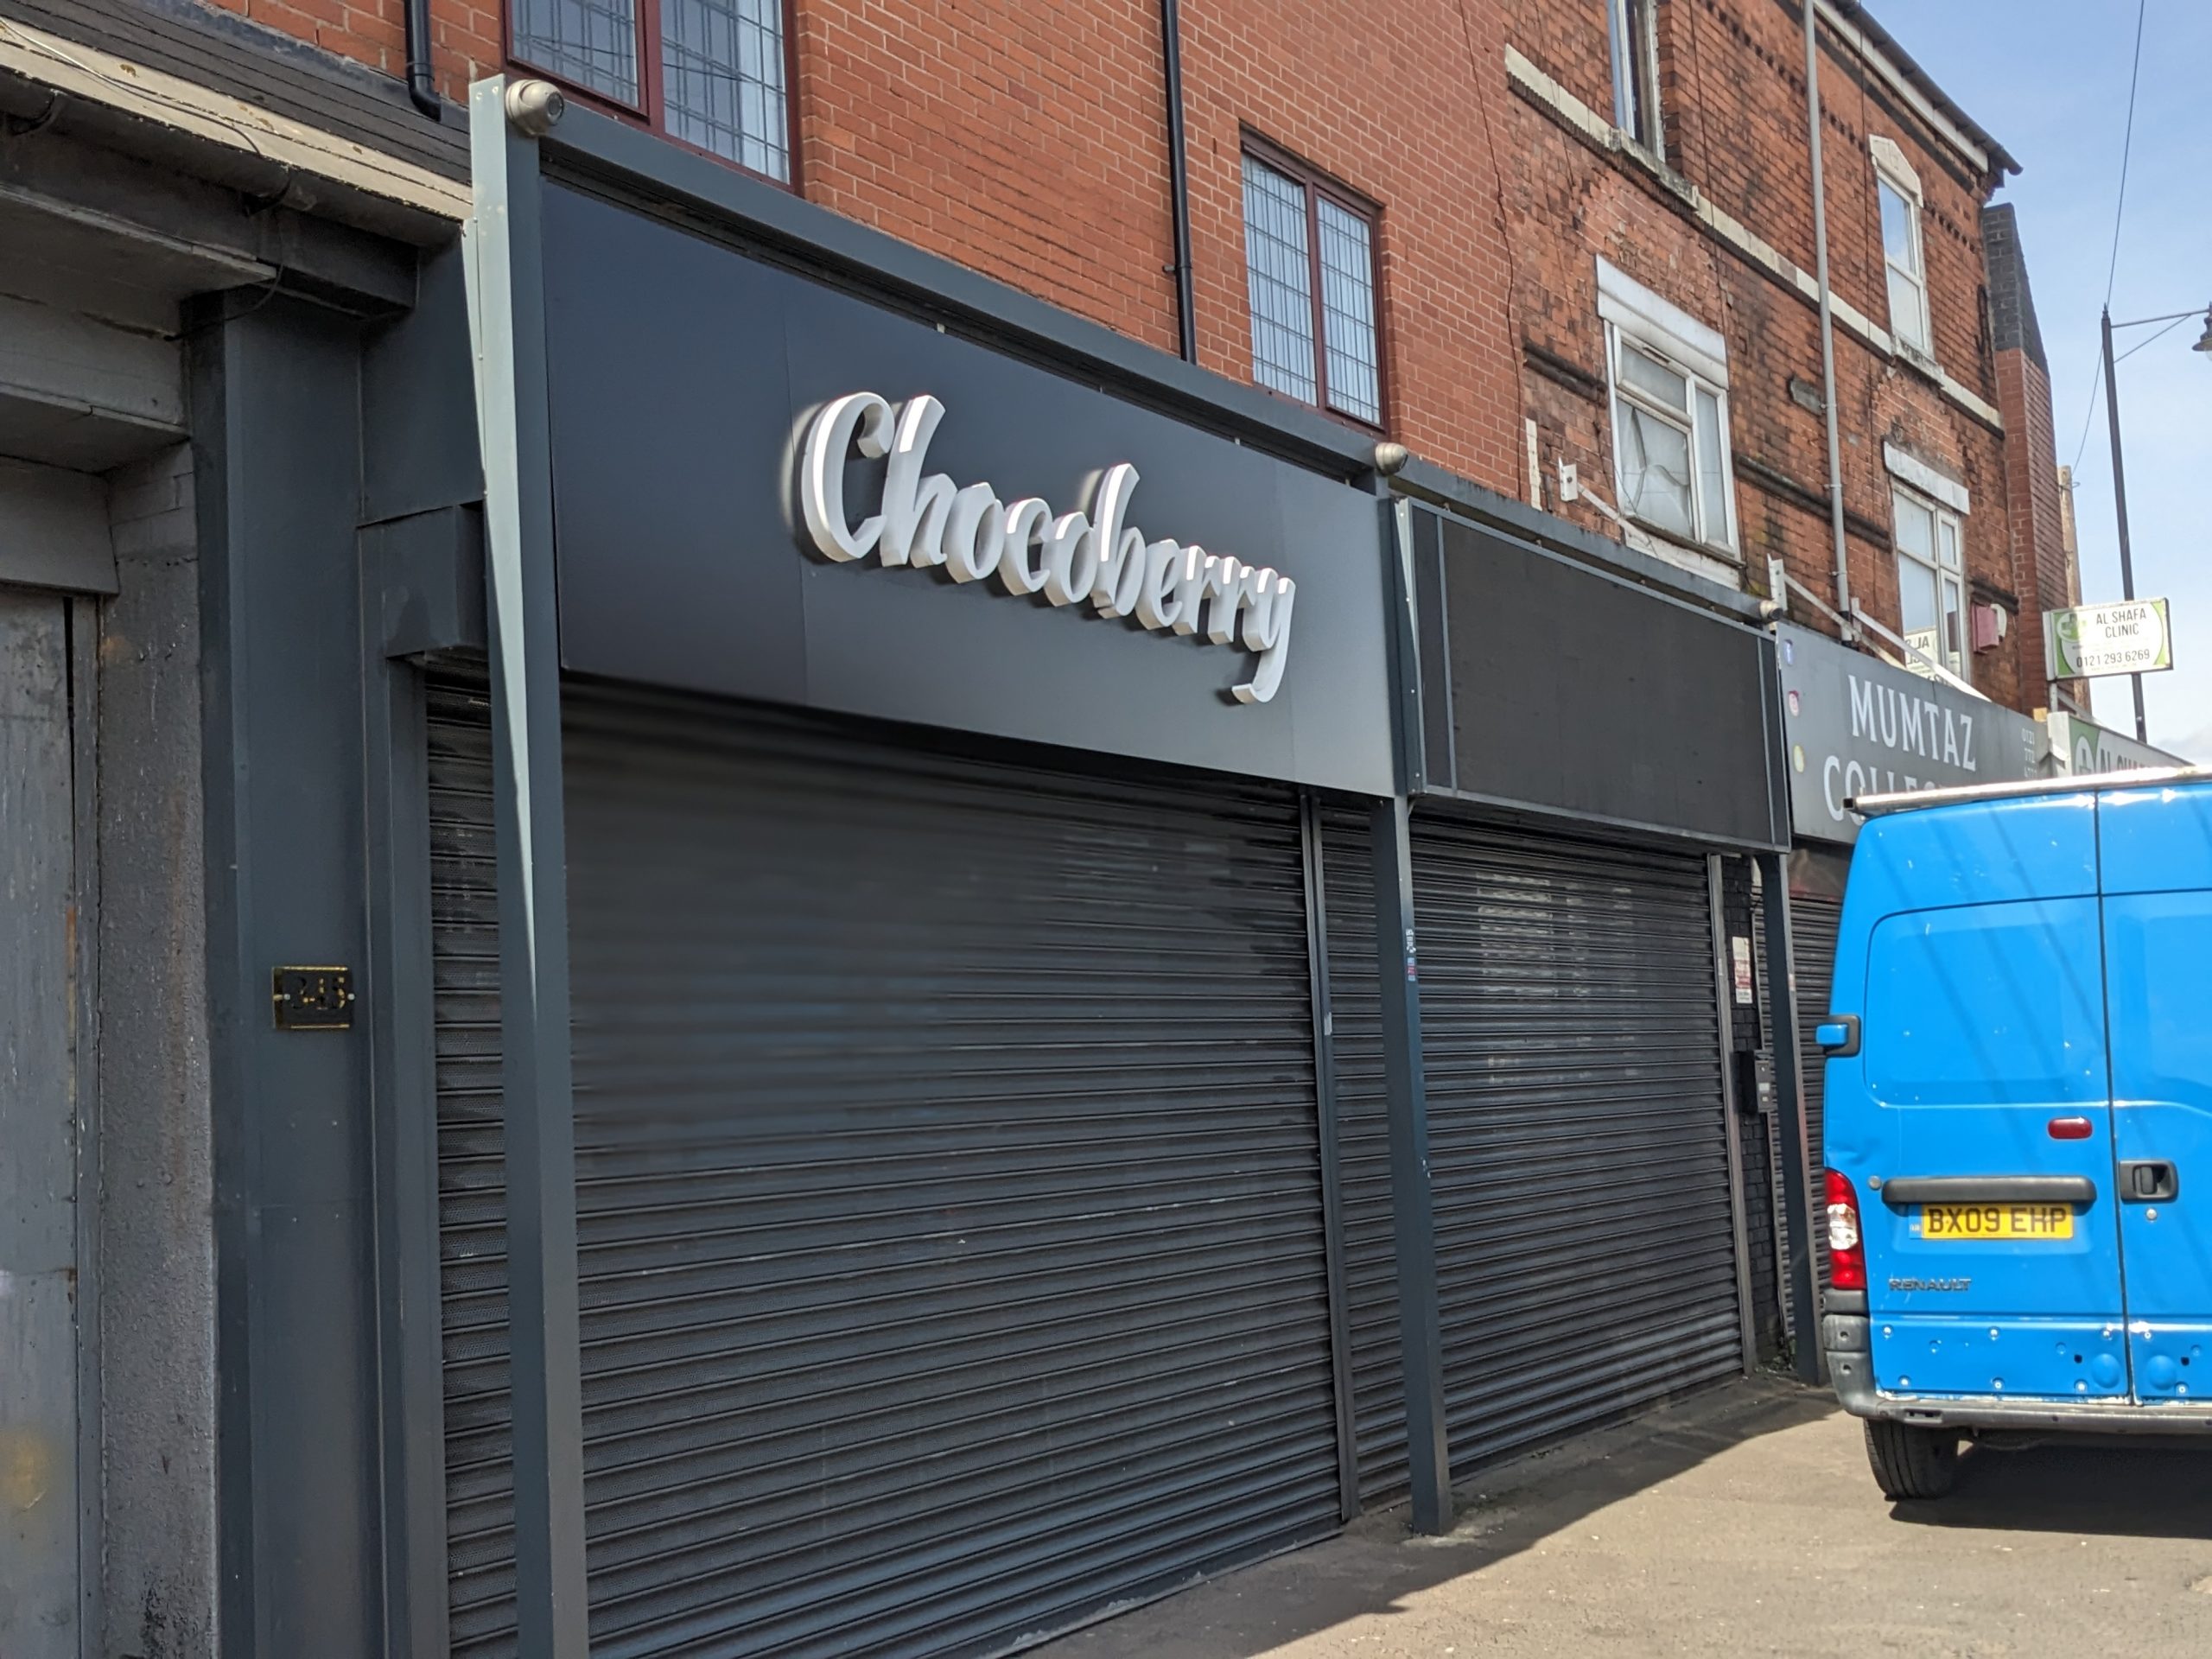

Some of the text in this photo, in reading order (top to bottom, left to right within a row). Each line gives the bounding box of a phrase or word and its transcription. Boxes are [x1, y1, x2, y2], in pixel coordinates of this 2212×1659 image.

[800, 391, 1295, 704] Chocoberry
[2095, 607, 2147, 625] AL SHAFA
[2105, 623, 2139, 639] CLINIC
[2076, 656, 2101, 668] 0121
[2104, 652, 2123, 664] 293
[2125, 649, 2151, 662] 6269
[1847, 674, 1976, 772] MUMTAZ
[1928, 1207, 2067, 1233] BX09 EHP
[1889, 1278, 1972, 1292] RENAULT
